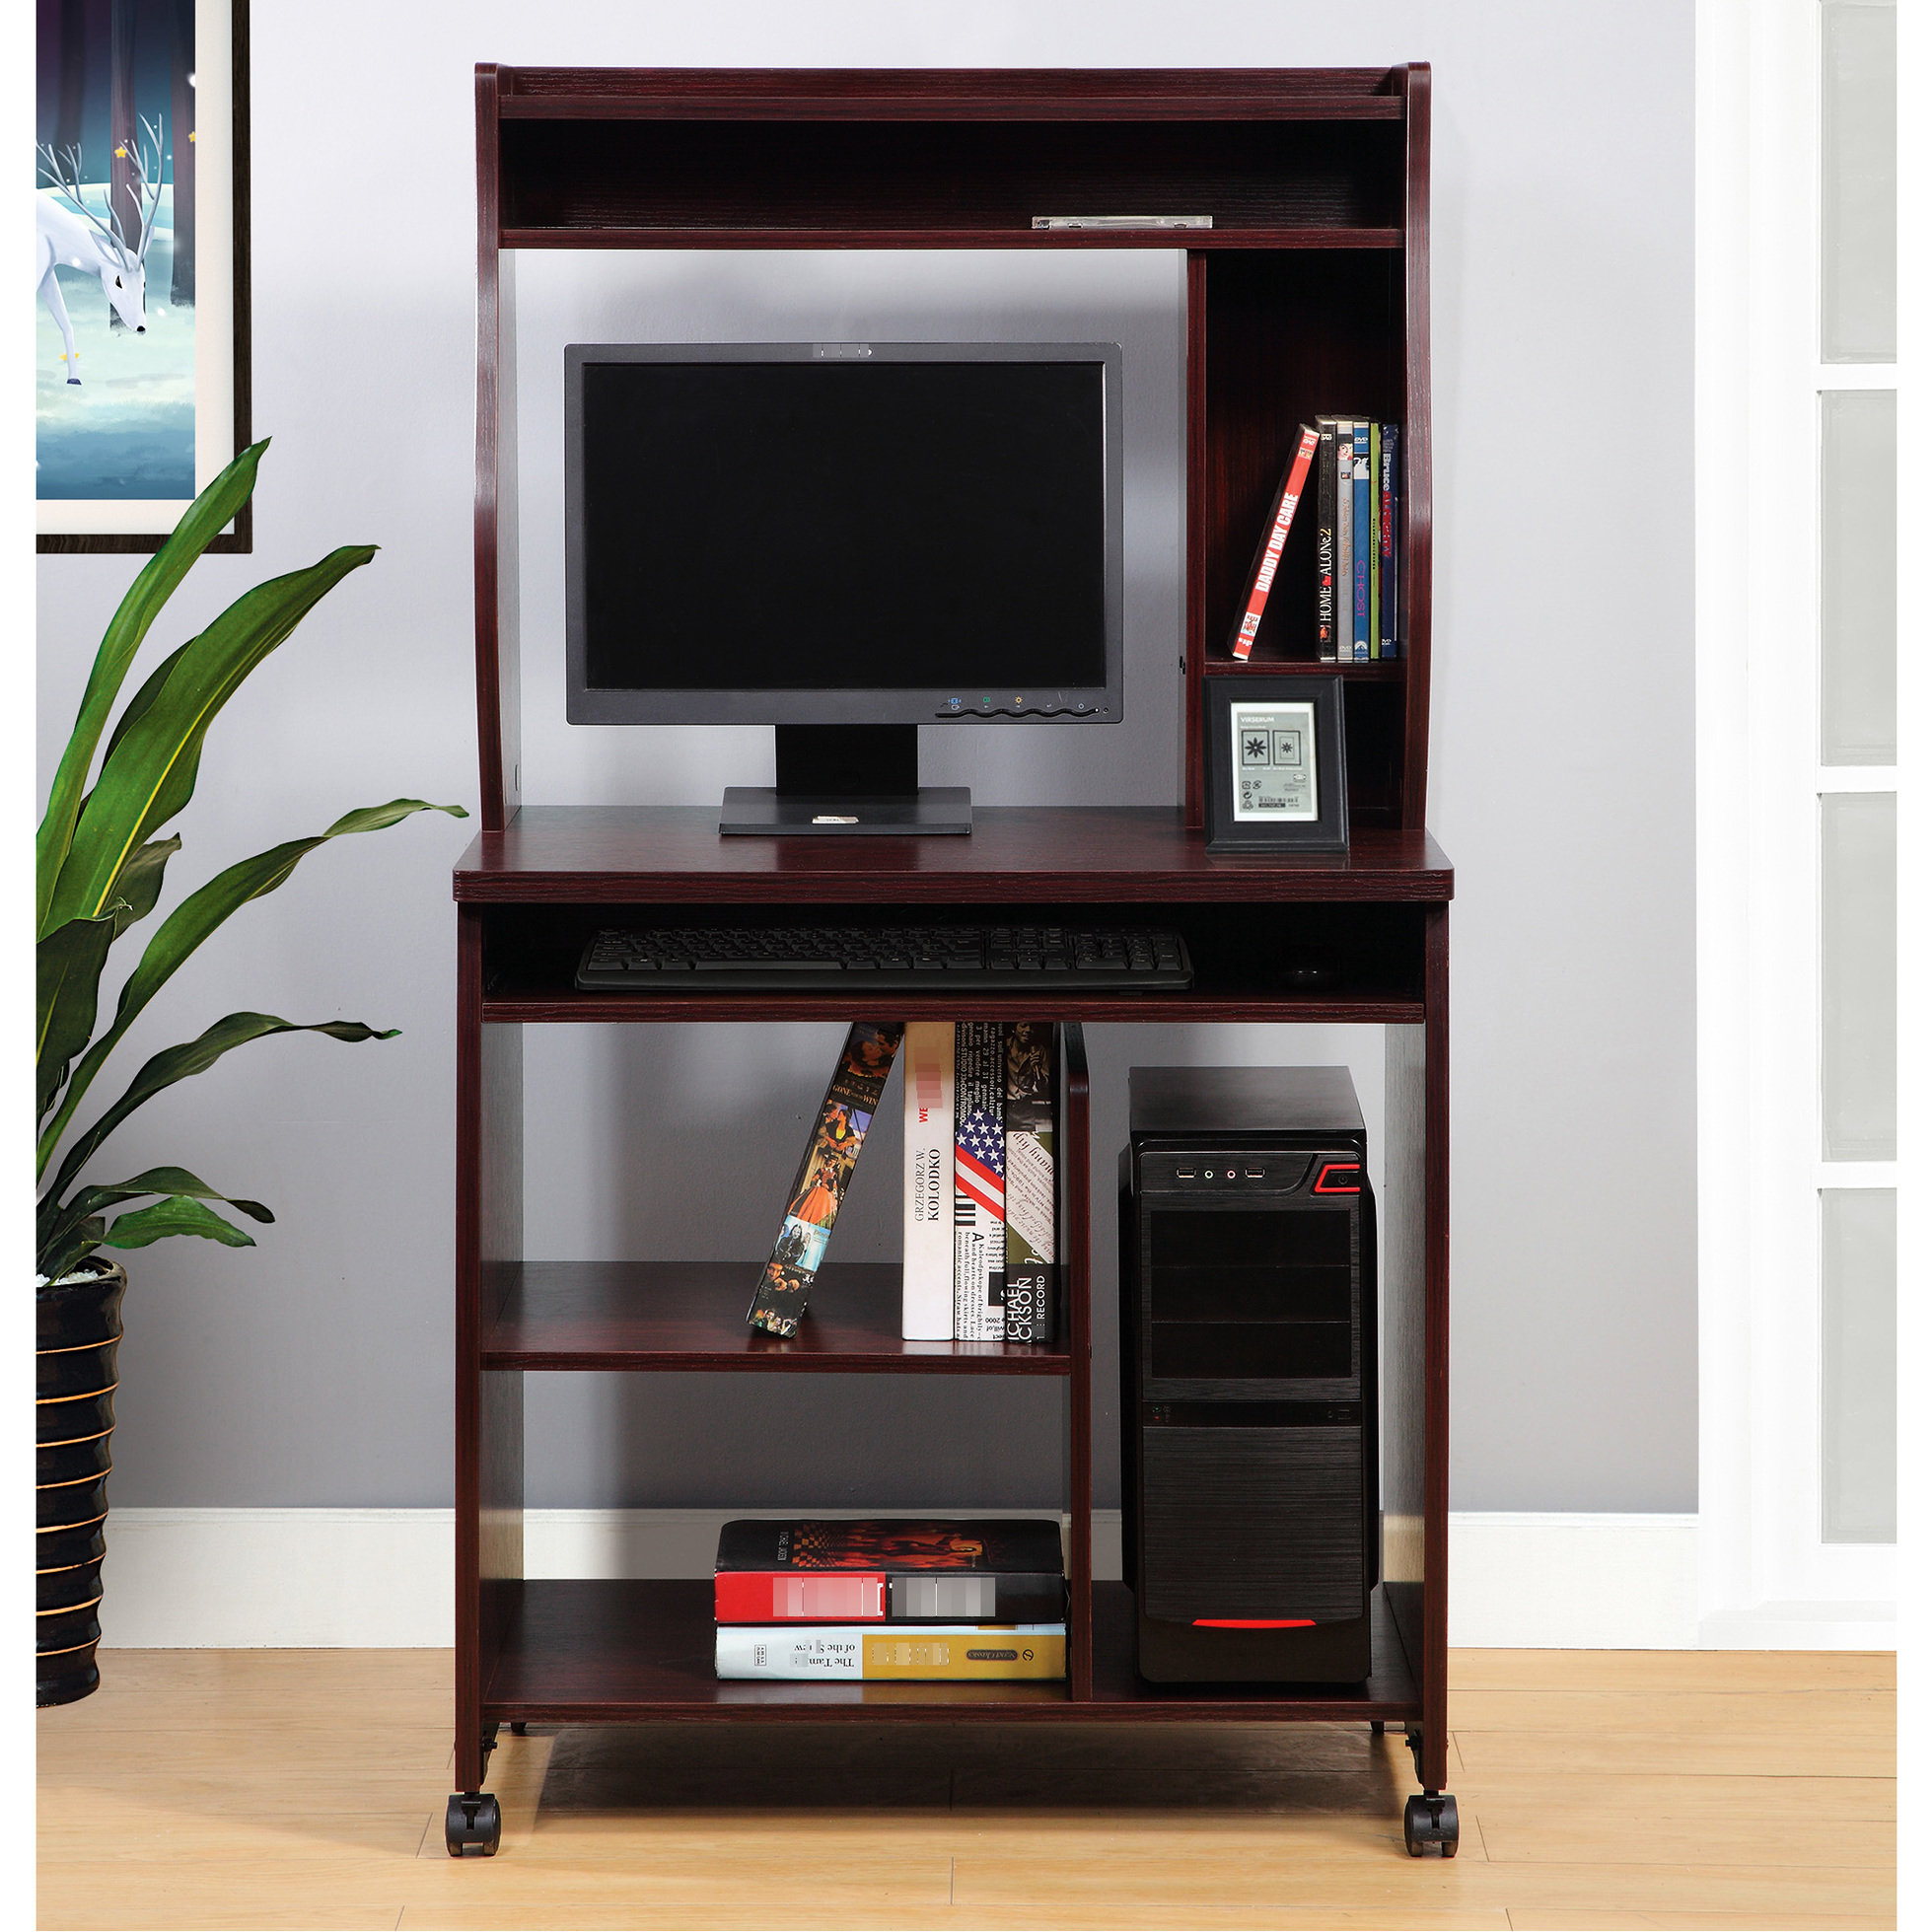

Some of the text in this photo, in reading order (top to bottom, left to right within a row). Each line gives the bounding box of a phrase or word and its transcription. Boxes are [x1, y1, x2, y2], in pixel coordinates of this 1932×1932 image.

[1383, 454, 1392, 491] Bruce
[1255, 491, 1299, 592] DADDY DAY CARE
[1320, 586, 1331, 621] HOME
[1013, 1132, 1032, 1151] hip
[914, 1164, 925, 1222] GRZEGORZ
[928, 1149, 940, 1222] KOLODKO
[971, 1233, 984, 1243] A
[1037, 1275, 1045, 1320] RECORD
[827, 1644, 843, 1654] the
[835, 1658, 855, 1668] The
[843, 1644, 856, 1654] of
